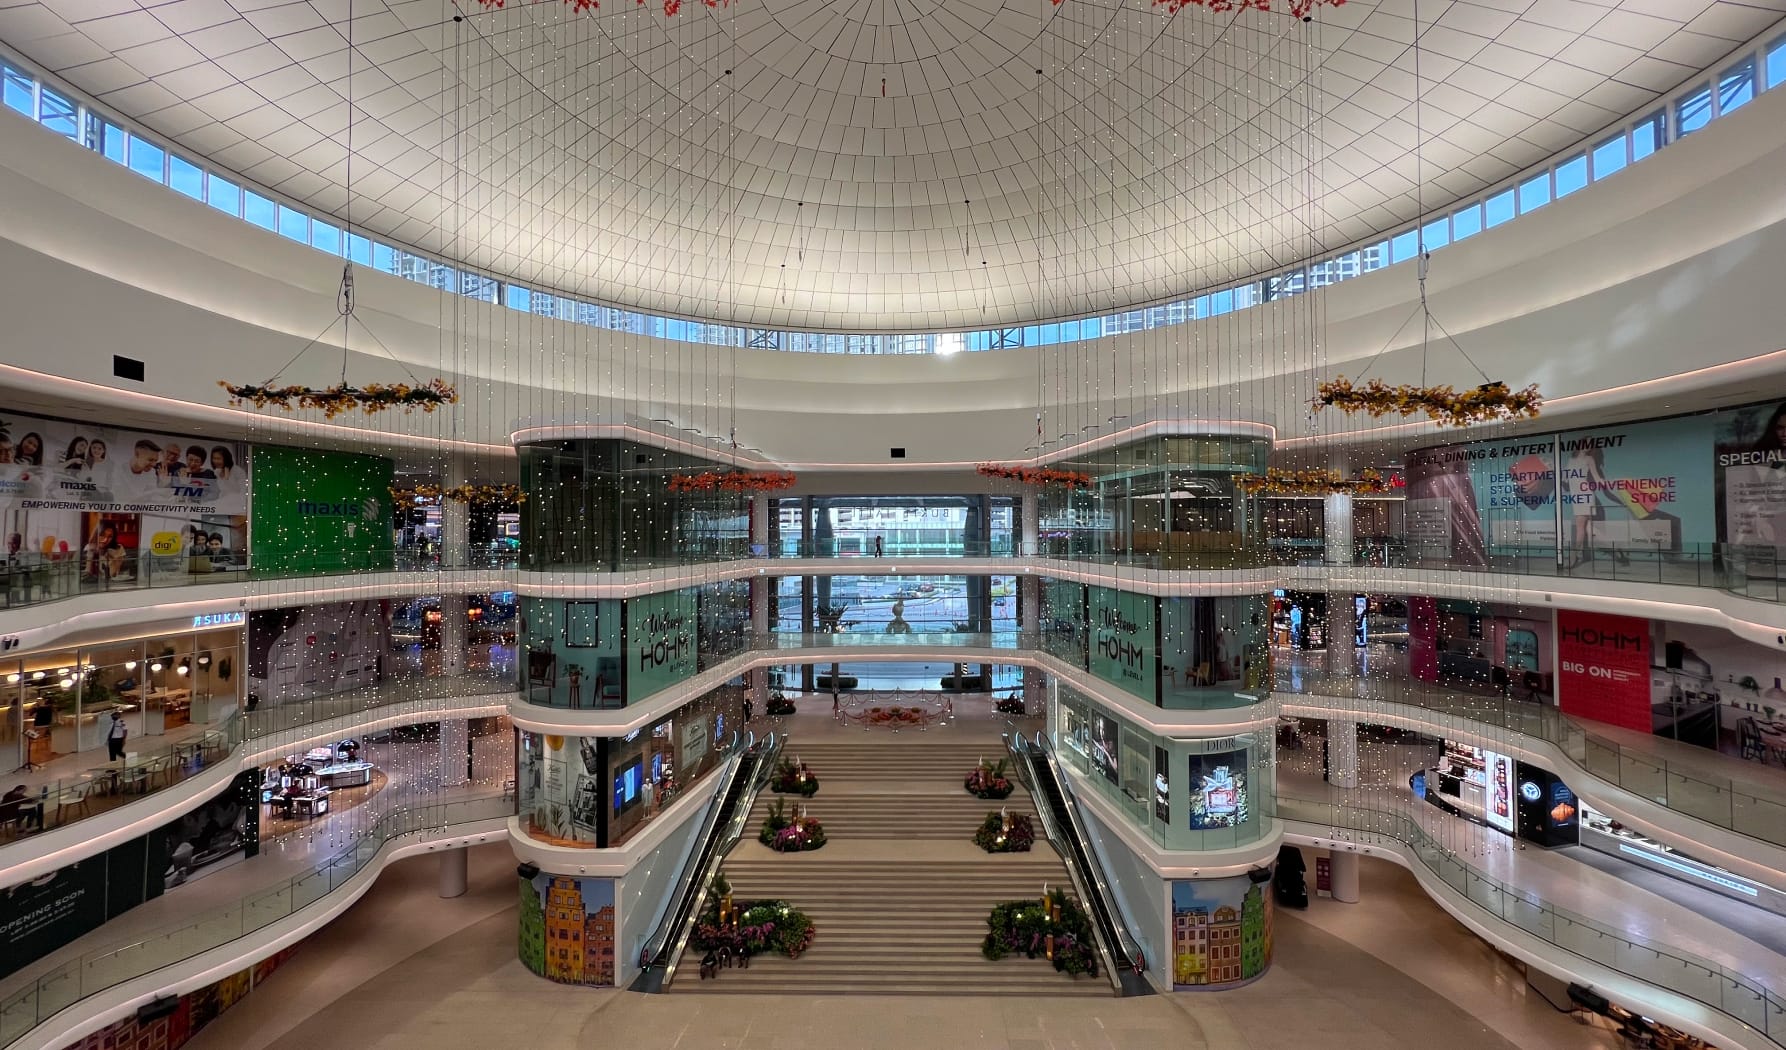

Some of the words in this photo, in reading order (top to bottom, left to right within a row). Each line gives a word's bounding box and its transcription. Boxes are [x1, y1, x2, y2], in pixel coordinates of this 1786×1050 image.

[1445, 449, 1486, 463] DINING
[1489, 447, 1498, 458] &
[1501, 434, 1627, 457] ENTERTAINMENT
[1719, 449, 1786, 466] SPECIAL
[60, 478, 97, 491] maxis
[1490, 484, 1528, 494] STORE
[1580, 477, 1676, 491] CONVENIENCE
[171, 486, 204, 497] TM
[1630, 491, 1676, 504] STORE
[22, 500, 85, 510] EMPOWERING
[89, 503, 107, 511] YOU
[123, 504, 188, 512] CONNECTIVITY
[297, 501, 358, 515] maxis
[1490, 498, 1498, 506] &
[155, 541, 172, 551] digi
[1562, 625, 1641, 652] HOHM
[641, 634, 688, 673] HOHM
[1098, 630, 1143, 671] HOHM
[1562, 661, 1585, 674] BIG
[1207, 738, 1234, 751] DIOR
[0, 903, 51, 933] OPENING
[55, 888, 85, 907] SOON
